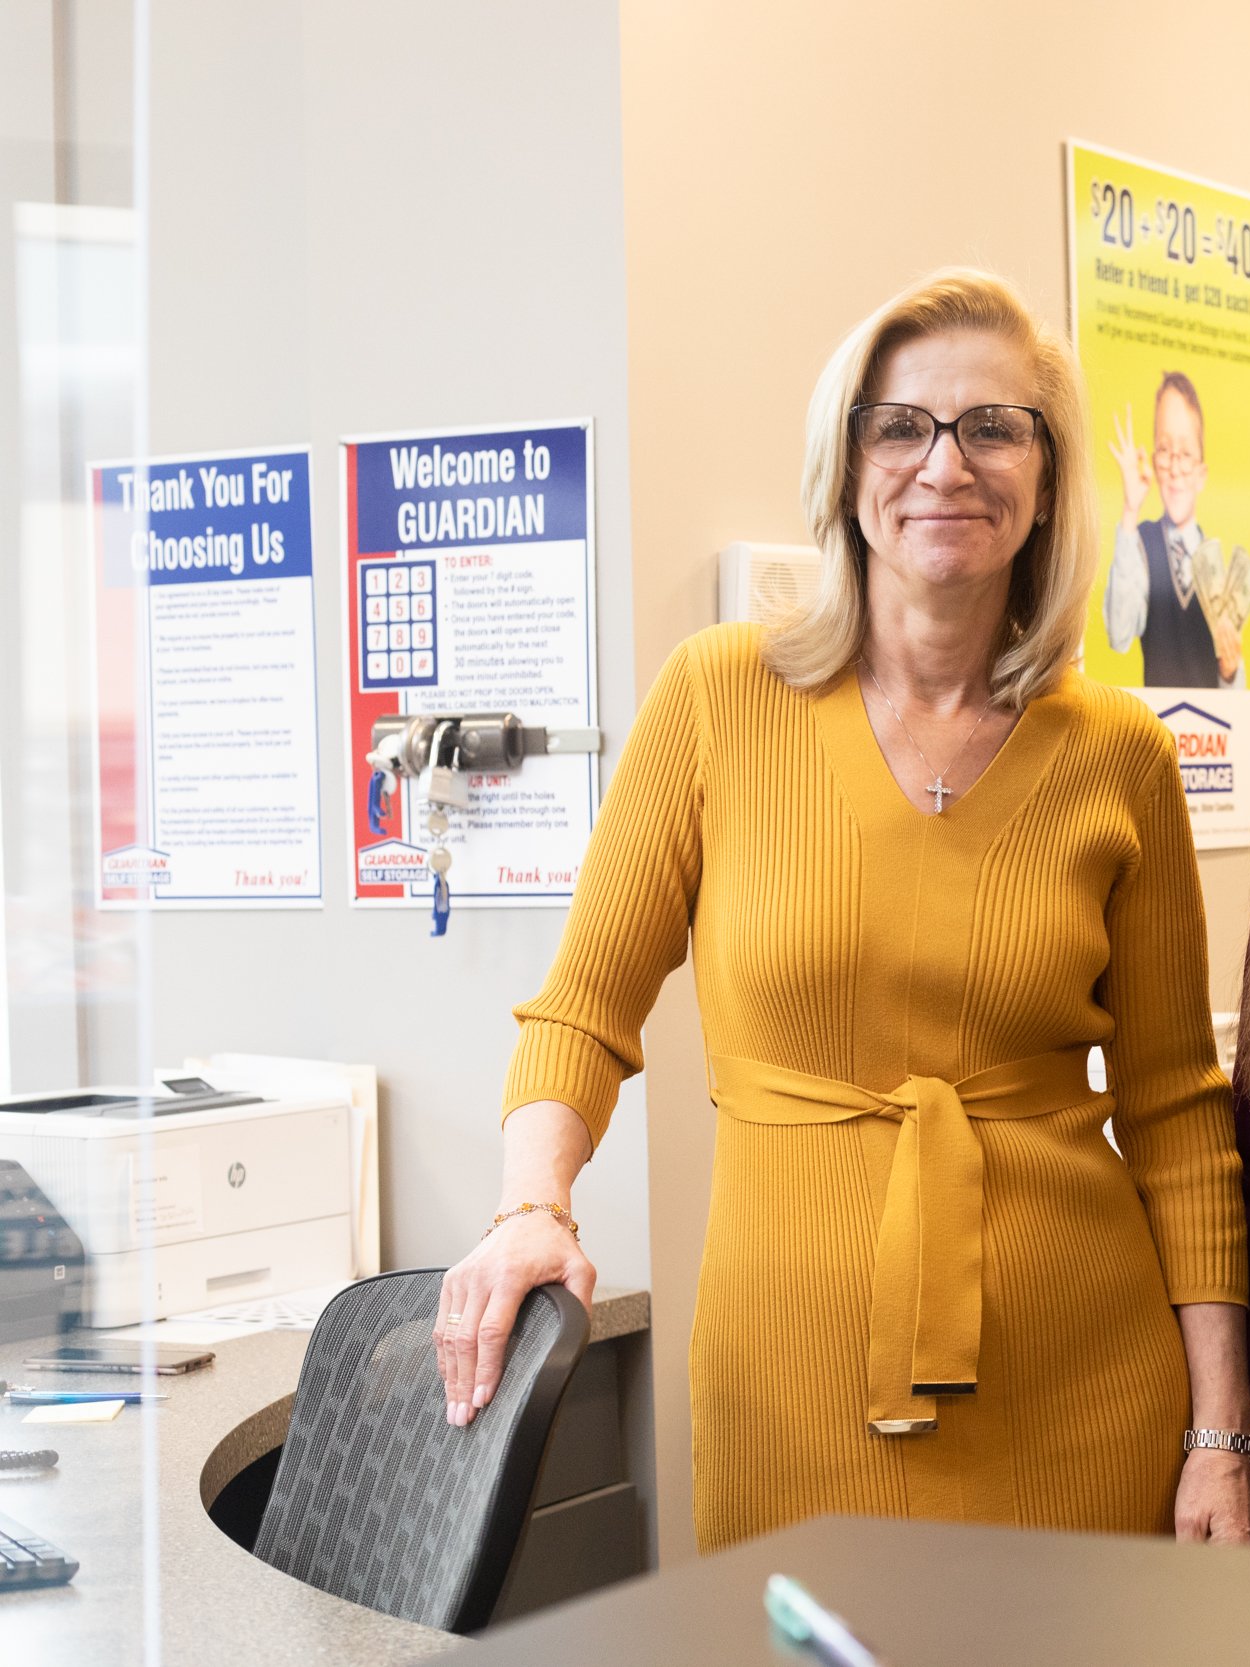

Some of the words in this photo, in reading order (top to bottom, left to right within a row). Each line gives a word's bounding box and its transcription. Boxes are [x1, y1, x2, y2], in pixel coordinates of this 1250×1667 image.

[1091, 181, 1133, 249] $20
[1156, 200, 1196, 265] $20
[1138, 269, 1168, 296] friend
[390, 444, 516, 490] Welcome
[523, 439, 551, 481] to
[117, 469, 195, 513] Thank
[199, 466, 245, 508] You
[252, 462, 293, 505] For
[398, 494, 545, 544] GUARDIAN
[131, 526, 244, 575] Choosing
[251, 522, 285, 565] Us
[444, 557, 457, 569] TO
[373, 574, 379, 590] 1
[395, 572, 403, 589] 2
[417, 571, 425, 588] 3
[373, 602, 381, 617] 4
[396, 600, 403, 617] 5
[417, 599, 425, 616] 6
[374, 630, 381, 647] 7
[396, 629, 403, 645] 8
[418, 628, 426, 645] 9
[396, 657, 404, 674] 0
[1178, 733, 1228, 758] RDIAN
[1181, 767, 1232, 790] TORAGE
[365, 854, 424, 865] GUARDIAN
[234, 869, 274, 886] Thank
[279, 869, 308, 889] you!
[498, 866, 540, 884] Thank
[546, 866, 578, 887] you!
